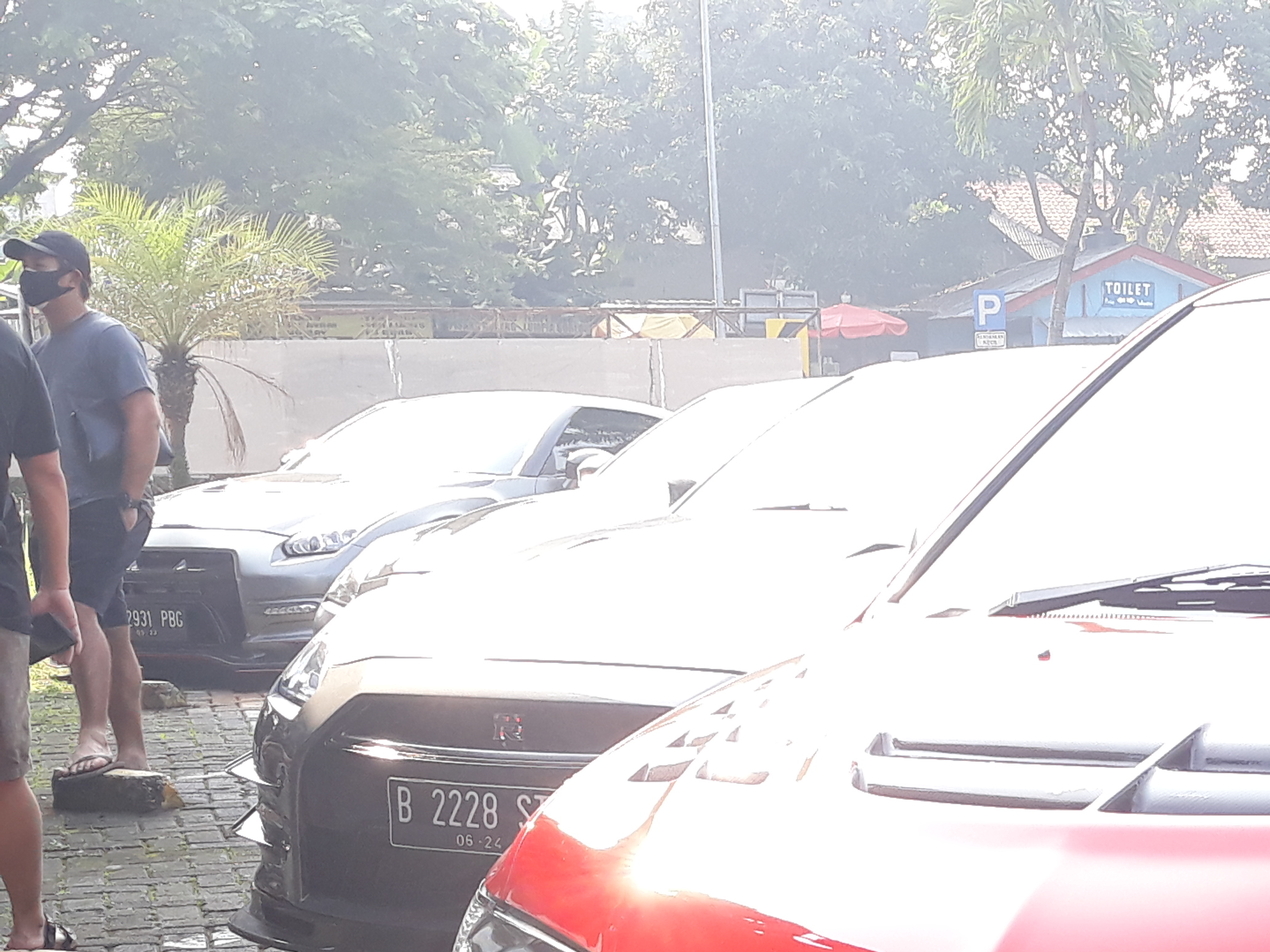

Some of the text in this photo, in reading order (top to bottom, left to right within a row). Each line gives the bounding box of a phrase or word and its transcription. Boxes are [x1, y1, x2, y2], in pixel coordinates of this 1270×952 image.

[1105, 281, 1151, 297] TOILET
[978, 294, 1001, 326] P
[161, 611, 183, 628] PBG
[397, 786, 412, 823] B
[432, 789, 498, 829] 2228
